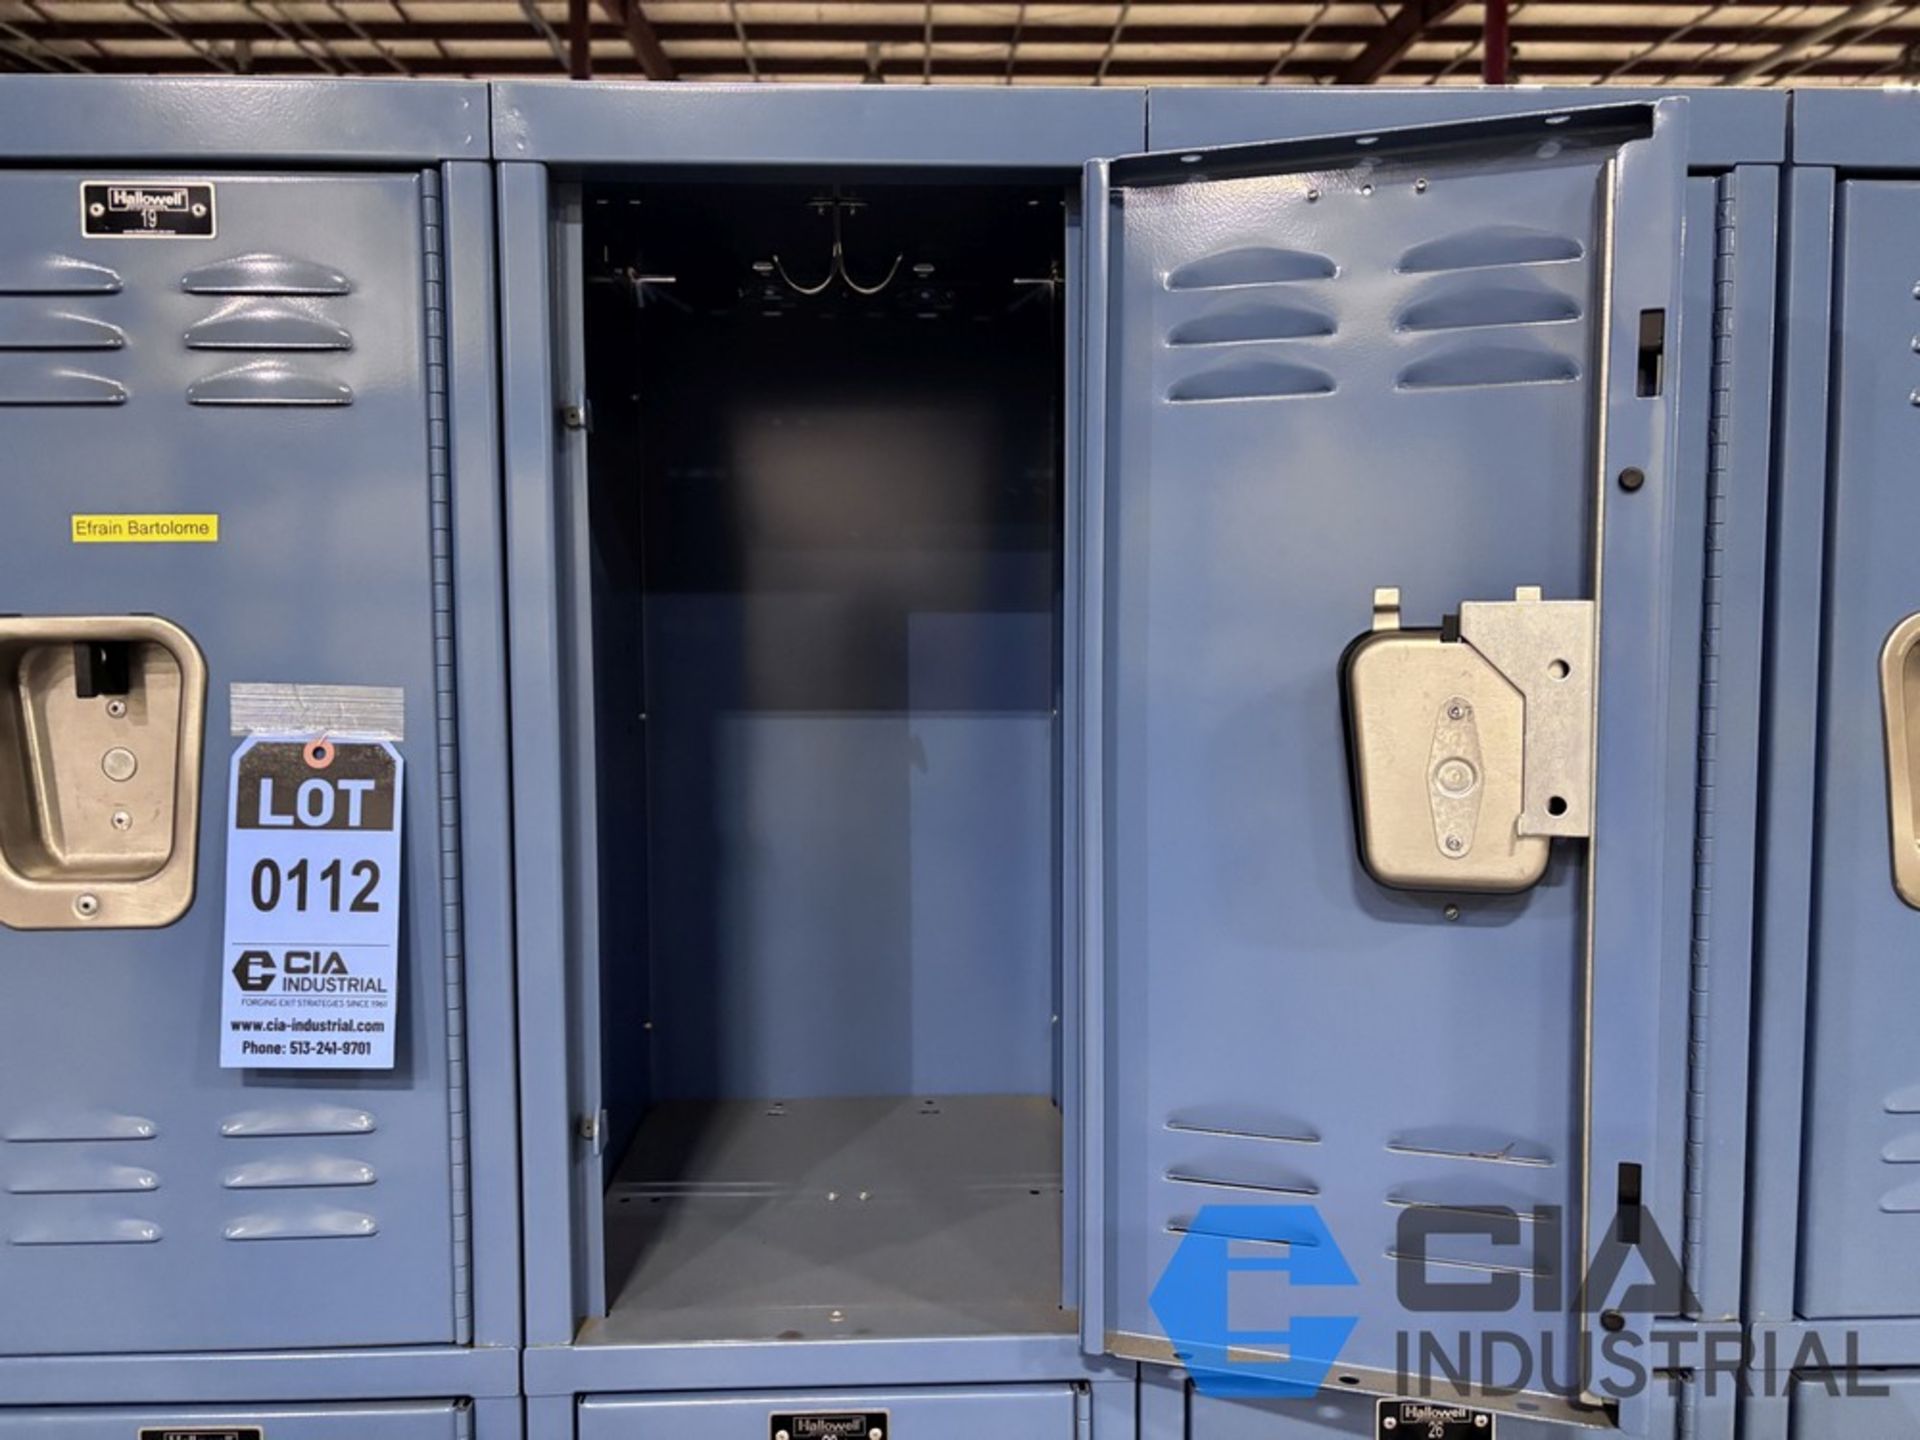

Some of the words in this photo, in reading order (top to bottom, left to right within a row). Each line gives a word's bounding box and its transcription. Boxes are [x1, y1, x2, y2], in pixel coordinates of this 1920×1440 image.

[113, 191, 182, 206] Hallowell
[141, 208, 157, 228] 19
[76, 520, 122, 536] Efrain
[128, 520, 210, 535] Bartolome
[258, 778, 375, 827] LOT
[252, 858, 380, 913] 0112
[283, 951, 348, 975] CIA
[282, 977, 388, 993] INDUSTRIAL
[230, 1018, 385, 1032] www.cia-industrial.com
[242, 1040, 286, 1055] Phone:
[290, 1041, 371, 1056] 513-241-9701
[1405, 1406, 1466, 1419] Hallowell
[798, 1419, 860, 1431] Hallowell
[1428, 1420, 1444, 1439] 26
